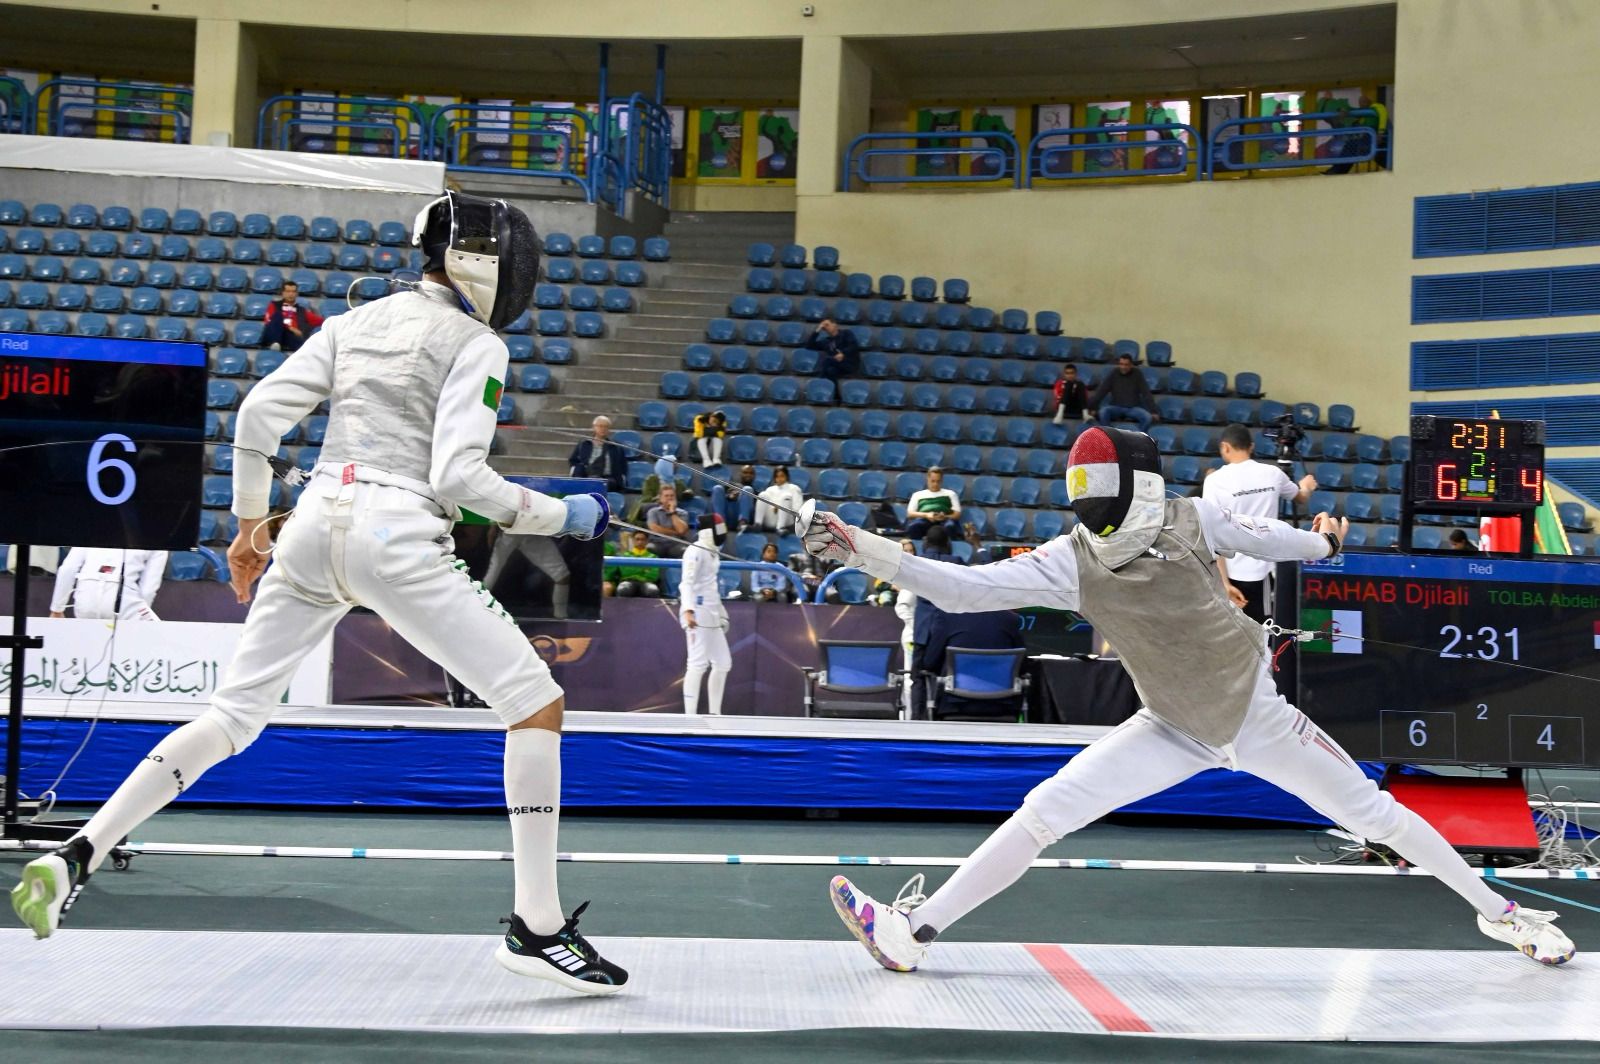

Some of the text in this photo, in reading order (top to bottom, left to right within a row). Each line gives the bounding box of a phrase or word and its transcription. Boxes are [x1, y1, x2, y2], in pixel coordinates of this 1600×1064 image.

[2, 338, 29, 350] Red
[1451, 423, 1505, 450] 2:31
[86, 433, 138, 505] 6
[1470, 452, 1486, 477] 2
[1437, 464, 1458, 500] 6
[1520, 469, 1541, 501] 4
[1468, 563, 1493, 576] Red
[1304, 579, 1469, 609] RAHAB Djilali
[1488, 590, 1545, 606] TOLBA
[1439, 624, 1520, 661] 2:31
[1476, 703, 1489, 721] 2
[1408, 719, 1428, 747] 6
[1536, 724, 1556, 751] 4
